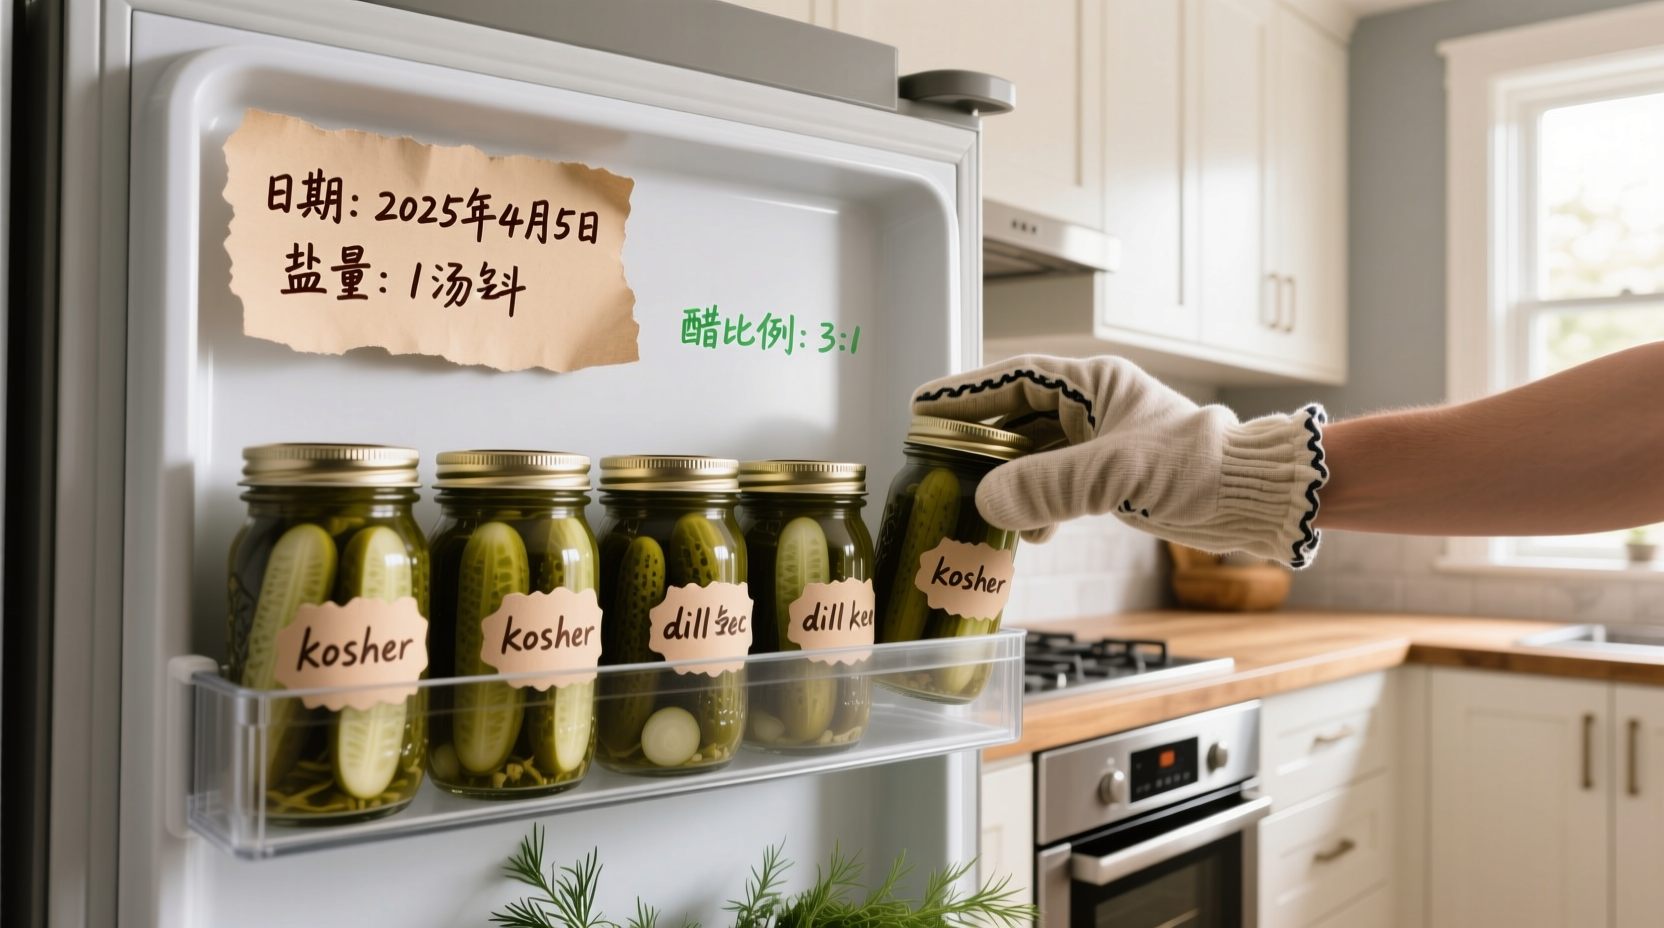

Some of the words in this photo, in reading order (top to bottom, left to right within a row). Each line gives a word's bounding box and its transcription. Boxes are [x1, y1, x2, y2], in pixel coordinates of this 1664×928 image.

[267, 168, 359, 225] 日期:
[374, 187, 600, 245] 2025年4月5日
[280, 242, 389, 301] 盐量:
[681, 304, 807, 356] 醋比例:
[817, 321, 861, 355] 3:1
[930, 555, 1007, 594] kosher
[501, 615, 595, 655] kosher
[662, 605, 711, 640] dill
[802, 601, 845, 632] dill
[296, 625, 414, 672] kosher
